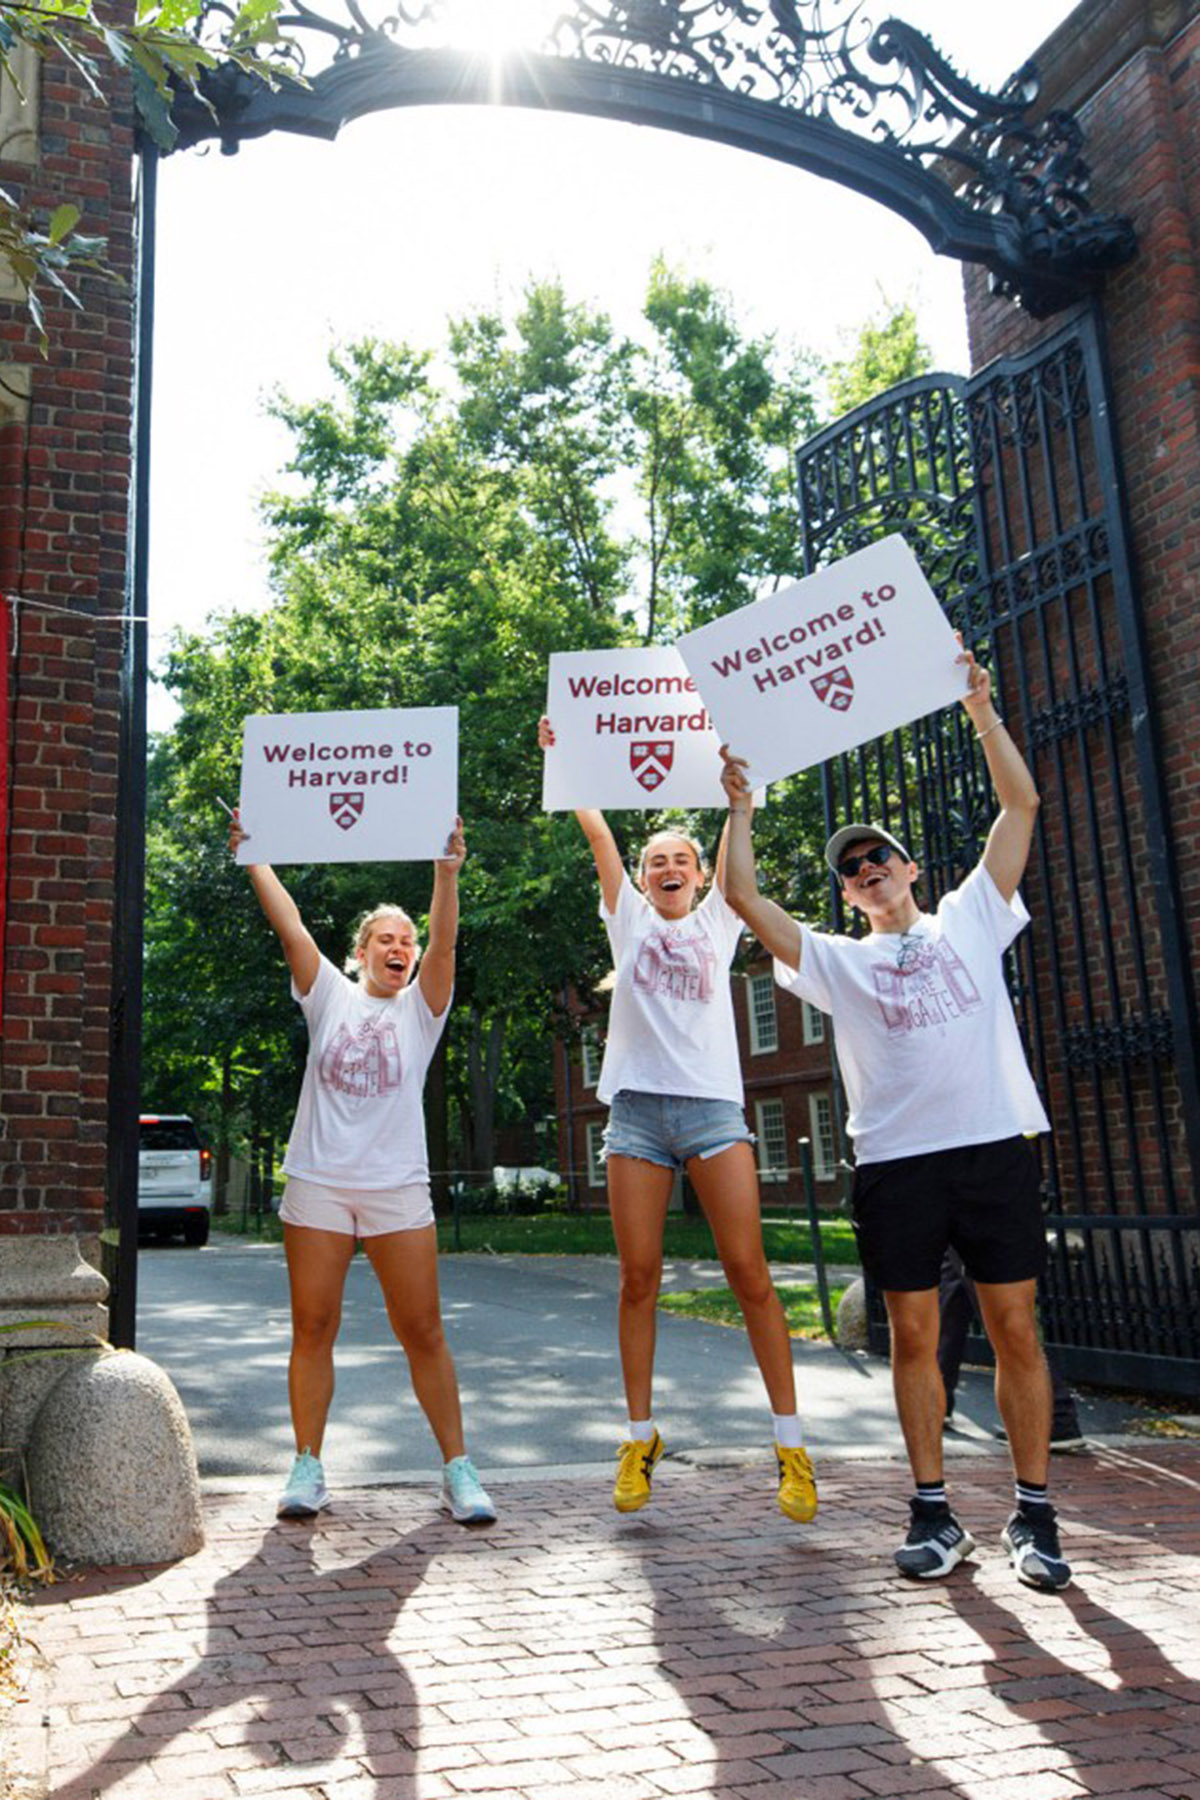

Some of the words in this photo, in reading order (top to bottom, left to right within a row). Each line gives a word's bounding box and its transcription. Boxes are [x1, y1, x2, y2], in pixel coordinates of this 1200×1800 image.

[710, 604, 855, 678] Welcome
[861, 584, 897, 608] to
[752, 617, 887, 693] Harvard!
[567, 673, 699, 699] Welcome
[263, 742, 394, 763] Welcome
[403, 740, 433, 758] to
[288, 764, 408, 788] Harvard!
